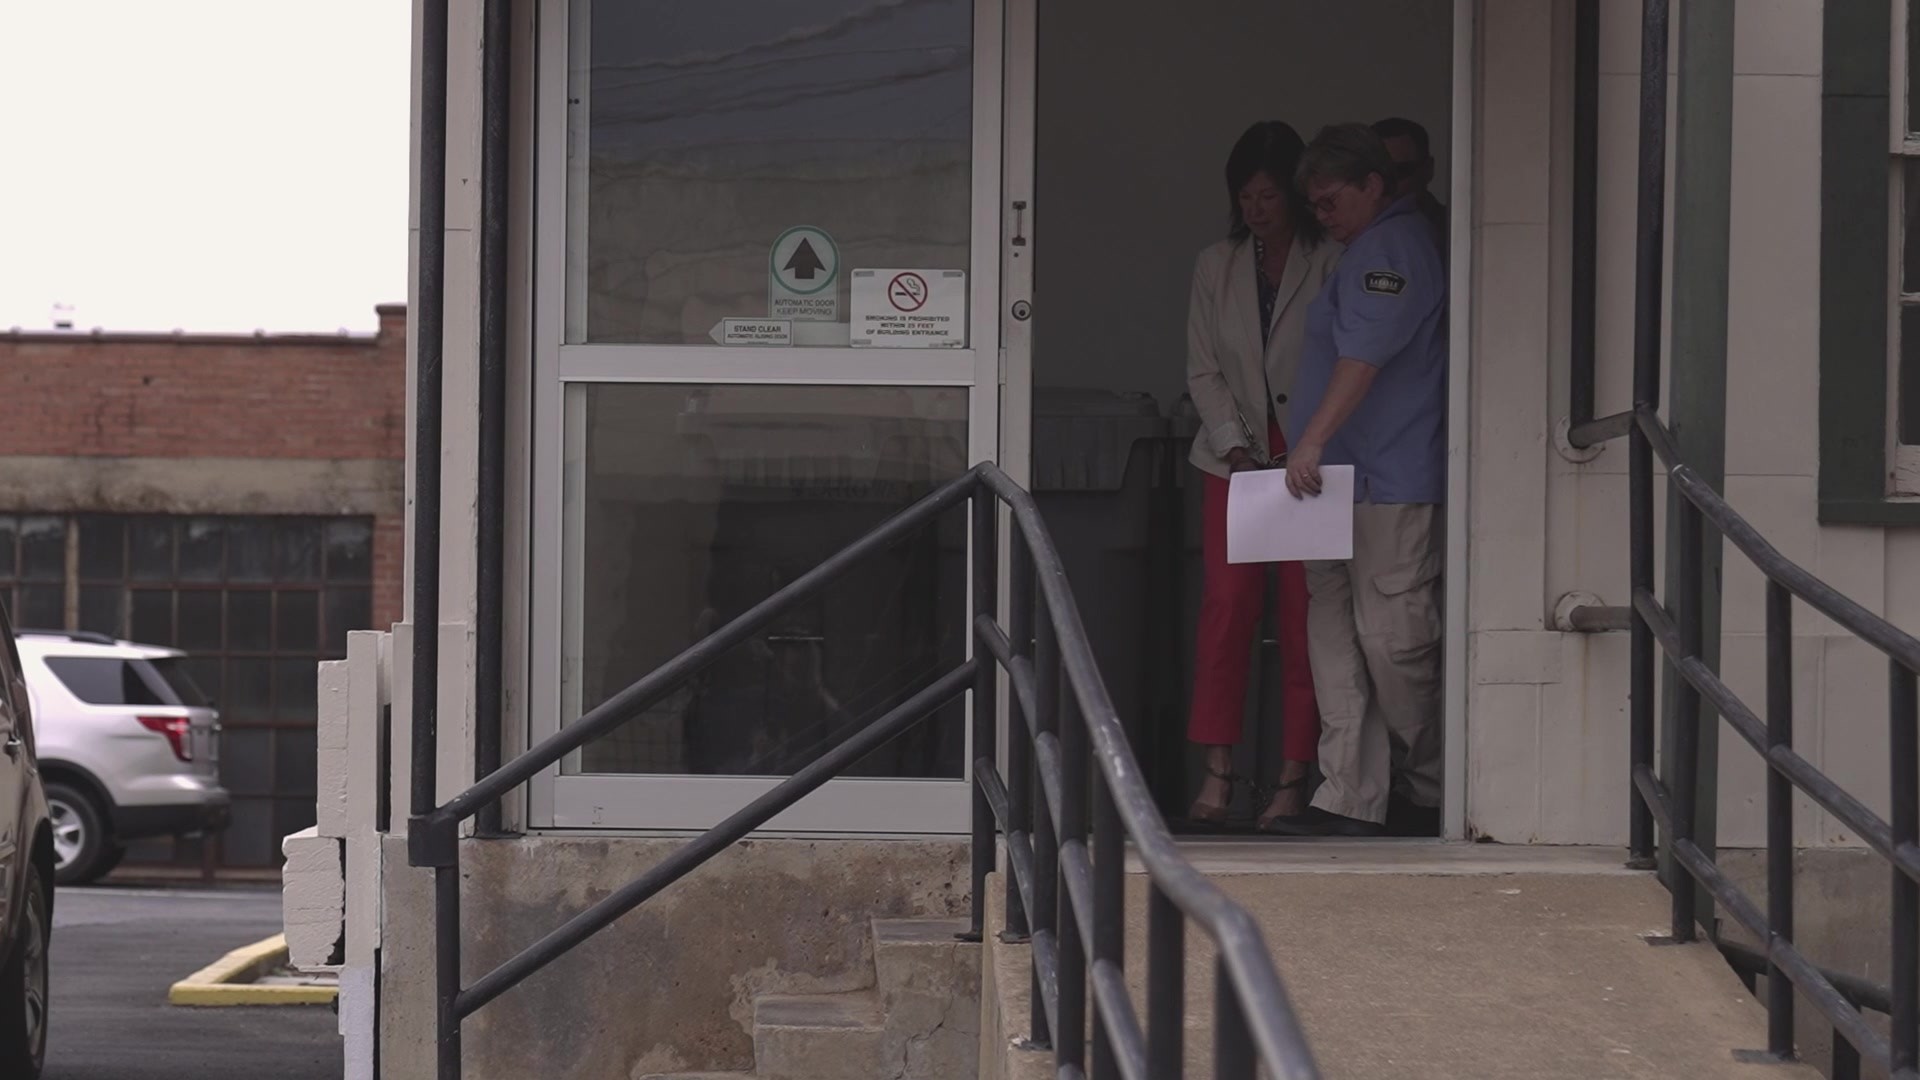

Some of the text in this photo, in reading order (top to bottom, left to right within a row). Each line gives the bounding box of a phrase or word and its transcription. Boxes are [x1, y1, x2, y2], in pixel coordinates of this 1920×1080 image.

[774, 298, 835, 307] AUTOMATIC DOOR
[776, 307, 832, 316] KEEP MOVING
[733, 325, 782, 333] STAND CLEAR
